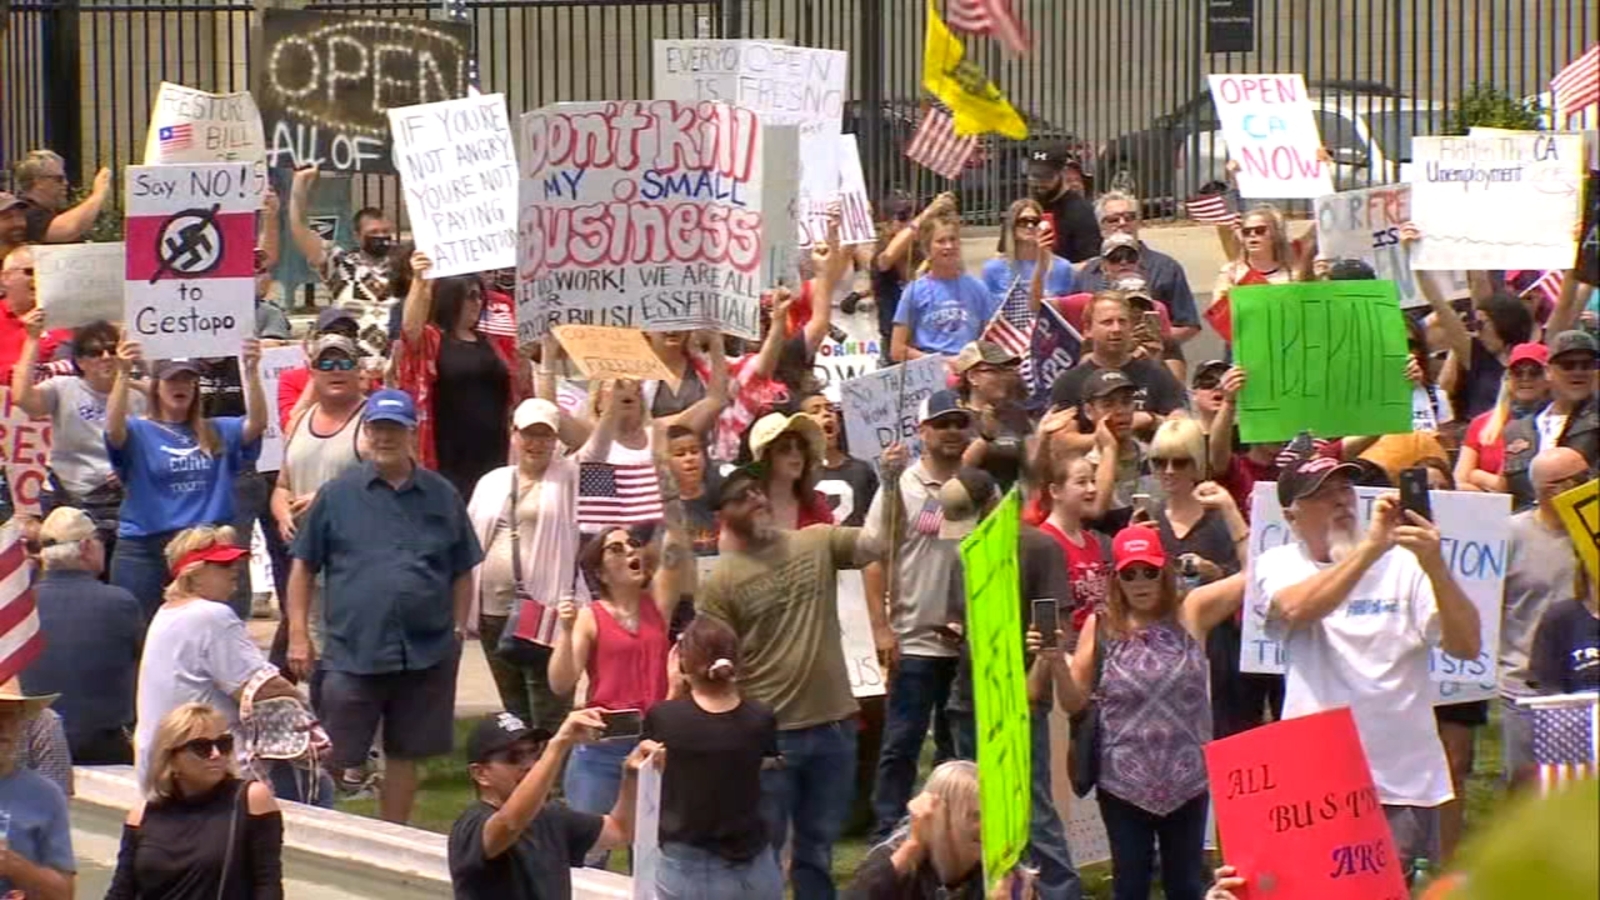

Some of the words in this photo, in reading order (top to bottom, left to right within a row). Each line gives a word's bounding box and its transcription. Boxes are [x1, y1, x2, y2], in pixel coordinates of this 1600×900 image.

[270, 35, 464, 113] OPEN
[744, 45, 834, 81] OPEN
[739, 75, 841, 118] FRESNO
[1218, 77, 1298, 104] OPEN
[206, 126, 254, 150] BILL
[399, 115, 426, 147] IF
[1241, 114, 1287, 138] CA
[267, 121, 326, 168] ALL
[331, 135, 384, 171] OF
[406, 148, 446, 182] NOT
[455, 134, 511, 167] ANGRY
[1240, 144, 1320, 180] NOW
[1532, 135, 1560, 161] CA
[133, 174, 175, 199] Say
[479, 164, 514, 193] NOT
[543, 170, 585, 201] MY
[640, 169, 747, 206] SMALL
[431, 198, 506, 238] PAYING
[1372, 227, 1399, 248] IS
[177, 283, 203, 301] to
[554, 267, 626, 294] WORK!
[638, 267, 674, 288] WE
[682, 265, 720, 288] ARE
[723, 270, 757, 298] ALL
[136, 306, 235, 334] Gestapo
[1227, 764, 1277, 800] ALL
[1330, 839, 1387, 879] ARE
